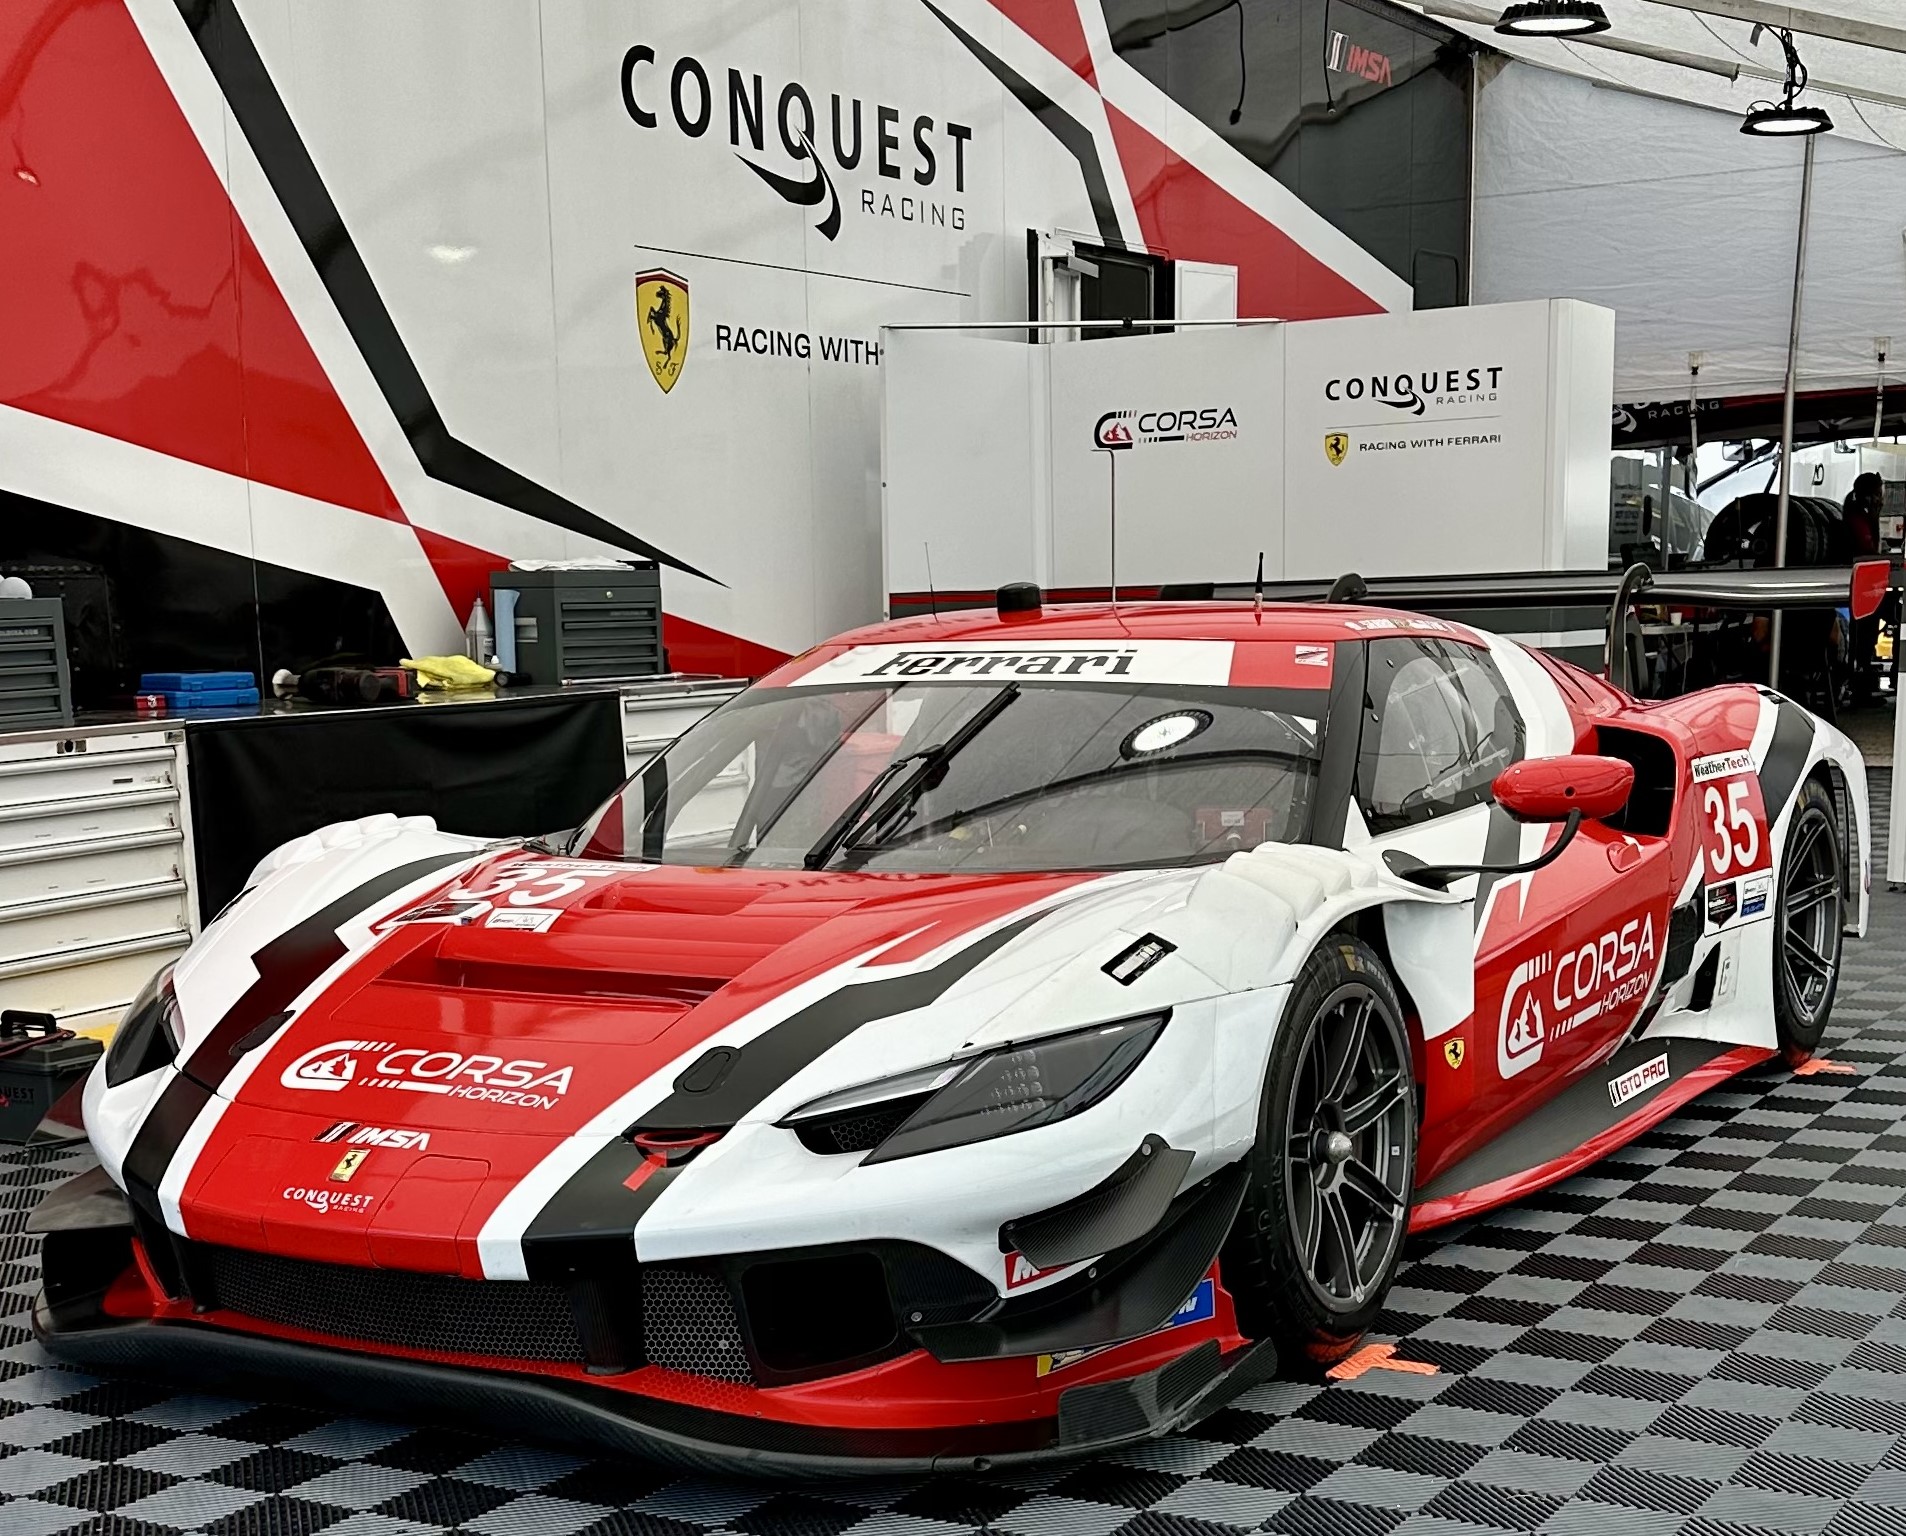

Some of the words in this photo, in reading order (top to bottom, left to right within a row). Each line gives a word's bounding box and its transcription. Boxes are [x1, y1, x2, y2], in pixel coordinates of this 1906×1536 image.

[1346, 44, 1392, 87] IMSA
[620, 44, 973, 193] CONQUEST
[861, 189, 965, 230] RACING
[716, 324, 811, 359] RACING
[819, 336, 880, 366] WITH
[1325, 366, 1502, 401] CONQUEST
[1436, 393, 1497, 405] RACING
[1648, 400, 1720, 419] RACING
[1138, 407, 1237, 433] CORSA
[1186, 430, 1238, 442] HORIZON
[1359, 440, 1407, 451] RACING
[1410, 437, 1444, 448] WITH
[1447, 434, 1501, 446] FERRARI
[861, 649, 1138, 677] Ferrari
[1694, 755, 1750, 777] WeatherTech
[1704, 780, 1759, 874] 35
[449, 868, 616, 906] 35
[1553, 912, 1655, 1011] CORSA
[1599, 968, 1653, 1016] HORIZON
[376, 1049, 574, 1095] CORSA
[1642, 1060, 1666, 1084] PRO
[447, 1084, 559, 1110] HORIZON
[347, 1126, 431, 1151] IMSA
[283, 1187, 374, 1208] CONQUEST
